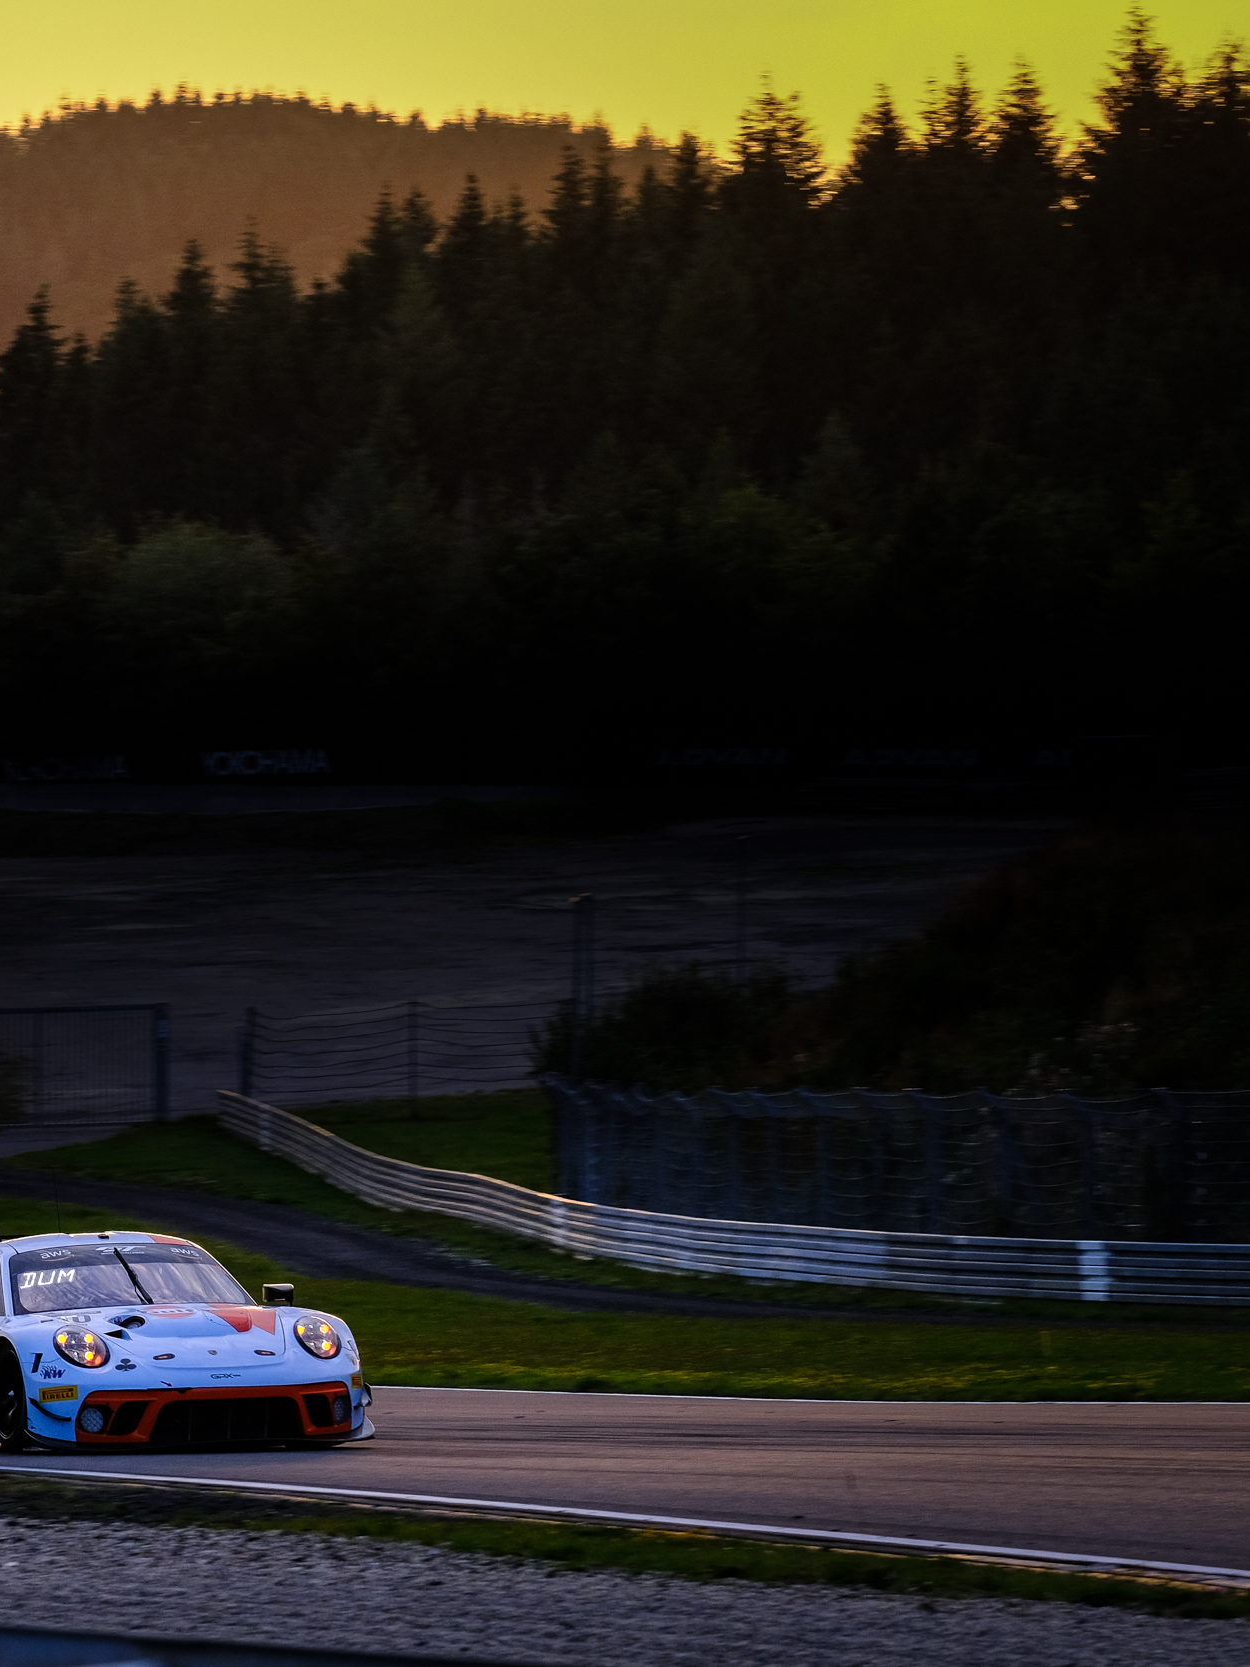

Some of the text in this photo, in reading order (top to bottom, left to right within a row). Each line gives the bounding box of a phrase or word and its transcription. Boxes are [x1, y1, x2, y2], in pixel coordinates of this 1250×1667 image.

[200, 749, 332, 776] YOKOHAMA
[40, 1249, 72, 1260] aws
[170, 1247, 200, 1257] aws
[19, 1268, 76, 1289] DUM
[41, 1387, 75, 1401] PIRELLI
